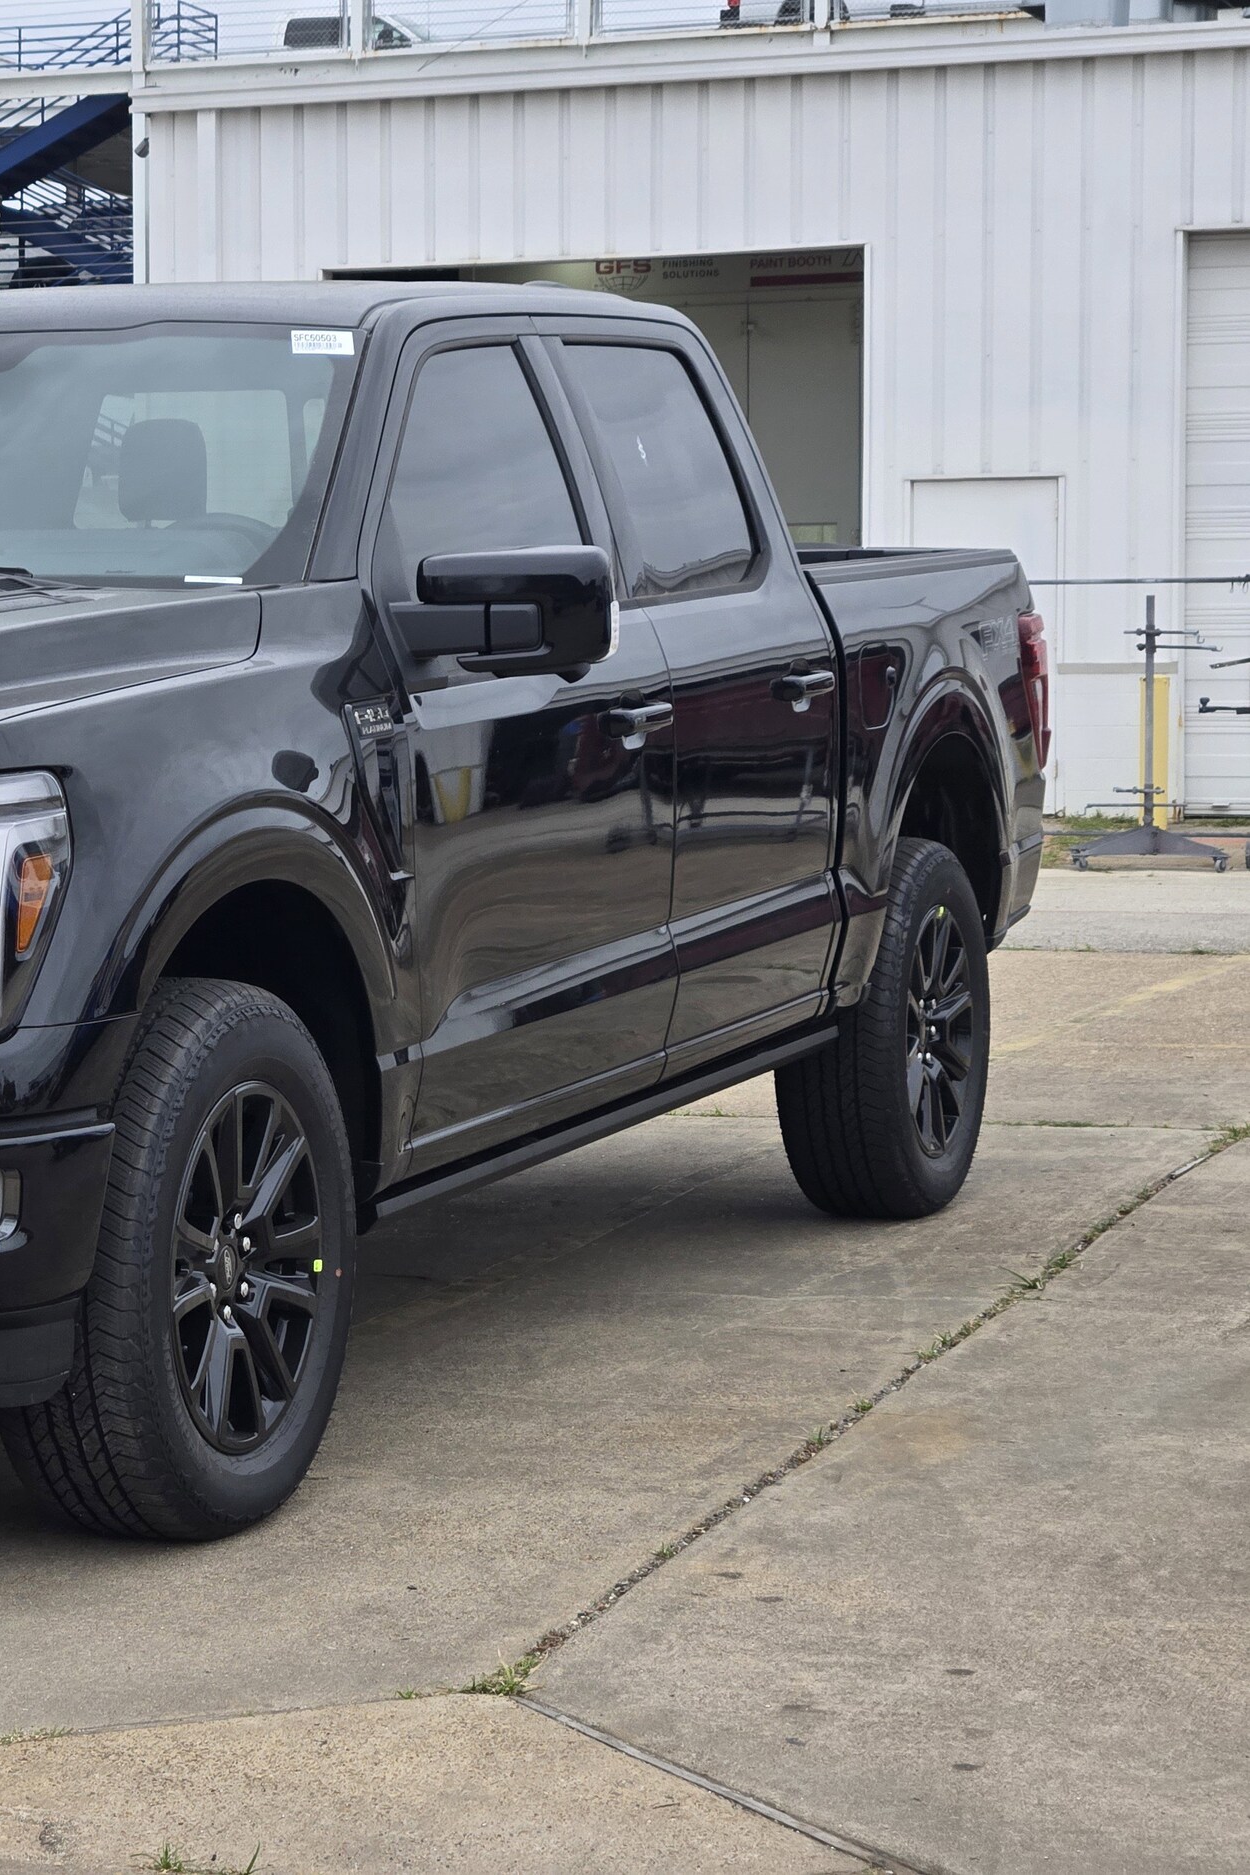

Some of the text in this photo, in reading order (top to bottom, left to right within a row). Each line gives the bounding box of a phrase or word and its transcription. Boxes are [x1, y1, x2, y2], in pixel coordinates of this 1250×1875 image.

[595, 260, 652, 275] GFS
[662, 258, 714, 268] FINISHING
[749, 254, 832, 269] PAINT BOOTH
[662, 269, 720, 279] SOLUTIONS
